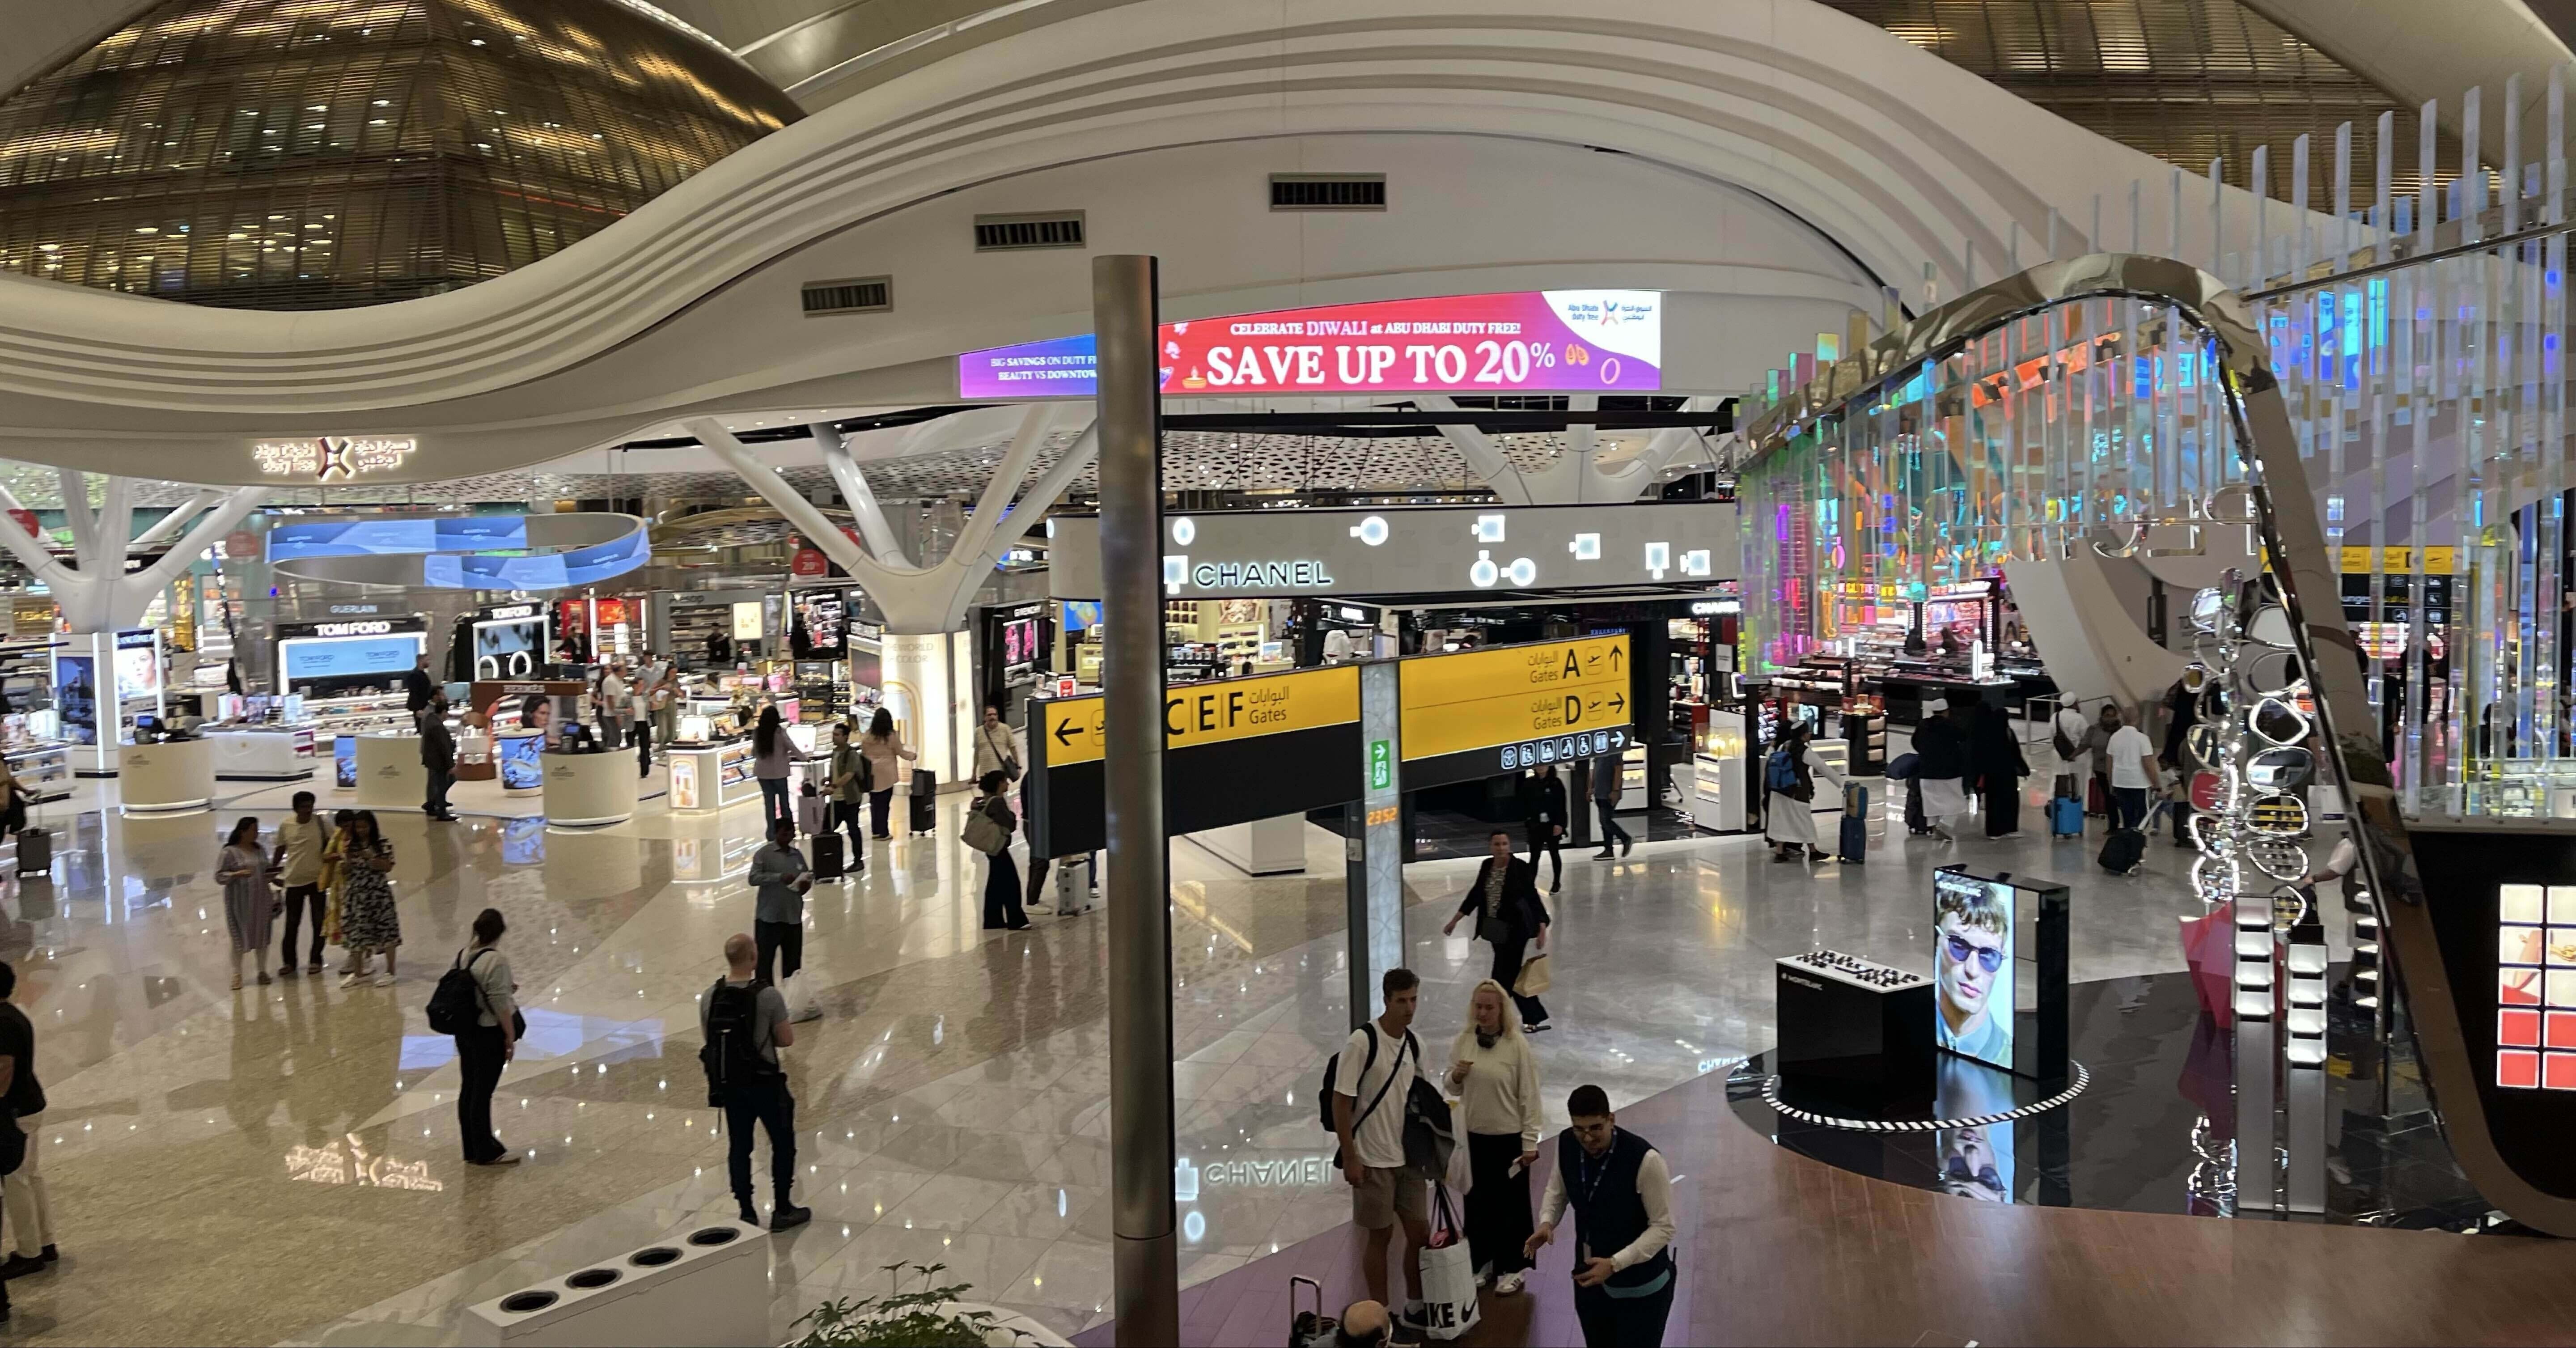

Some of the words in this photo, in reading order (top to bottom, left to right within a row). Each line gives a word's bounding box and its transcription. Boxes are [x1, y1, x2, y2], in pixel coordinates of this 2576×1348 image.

[1230, 322, 1304, 335] CELEBRATE
[1306, 321, 1368, 336] DIWALI
[1370, 323, 1383, 334] at
[1384, 323, 1411, 334] ABU
[1412, 322, 1451, 334] DHABI
[1453, 322, 1487, 334] DUTY
[1487, 322, 1521, 334] FREE!
[1007, 357, 1046, 366] SAVINGS
[1047, 357, 1061, 365] ON
[1062, 356, 1085, 365] DUTY
[1207, 346, 1326, 386] SAVE
[1335, 345, 1396, 384] UP
[1405, 345, 1467, 384] TO
[1474, 340, 1556, 384] 20%
[998, 371, 1033, 380] BEAUTY
[1047, 370, 1097, 379] DOWNTOW
[1194, 562, 1334, 588] CHANEL
[330, 605, 377, 613] GUERLAIN
[314, 623, 348, 636] TOM
[352, 621, 391, 634] FORD
[1562, 649, 1580, 679] A
[1530, 670, 1559, 683] Gates
[1249, 686, 1289, 707] البوابات
[1166, 698, 1185, 735] C
[1199, 695, 1216, 732] E
[1228, 691, 1244, 728] F
[1249, 708, 1287, 724] Gates
[1565, 695, 1581, 725] D
[1534, 716, 1562, 730] Gates
[1424, 1302, 1455, 1328] IKE
